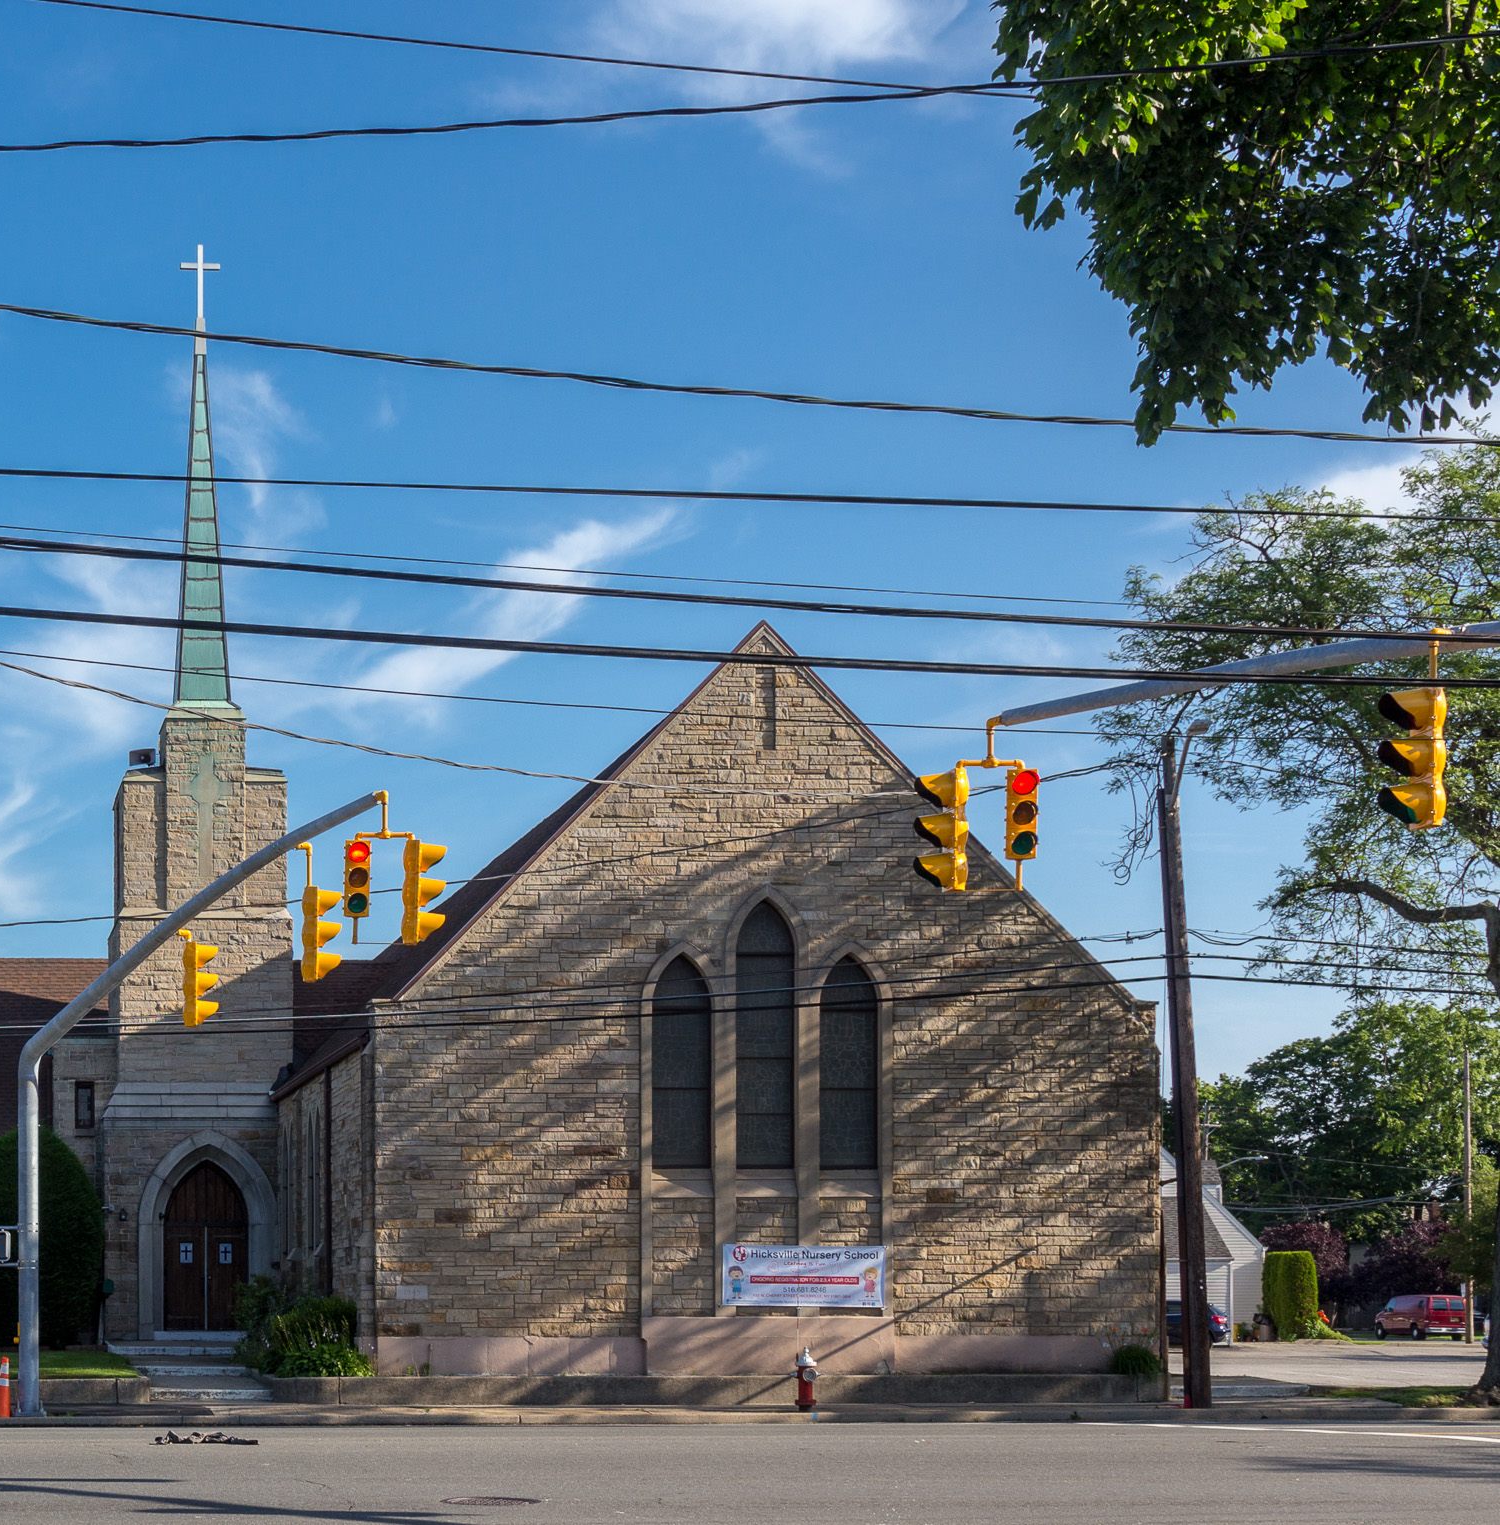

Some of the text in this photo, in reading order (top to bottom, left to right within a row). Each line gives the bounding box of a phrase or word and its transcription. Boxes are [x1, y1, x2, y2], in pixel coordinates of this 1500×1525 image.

[751, 1250, 799, 1259] Hicksville
[802, 1250, 840, 1261] Nursery
[844, 1251, 879, 1260] School
